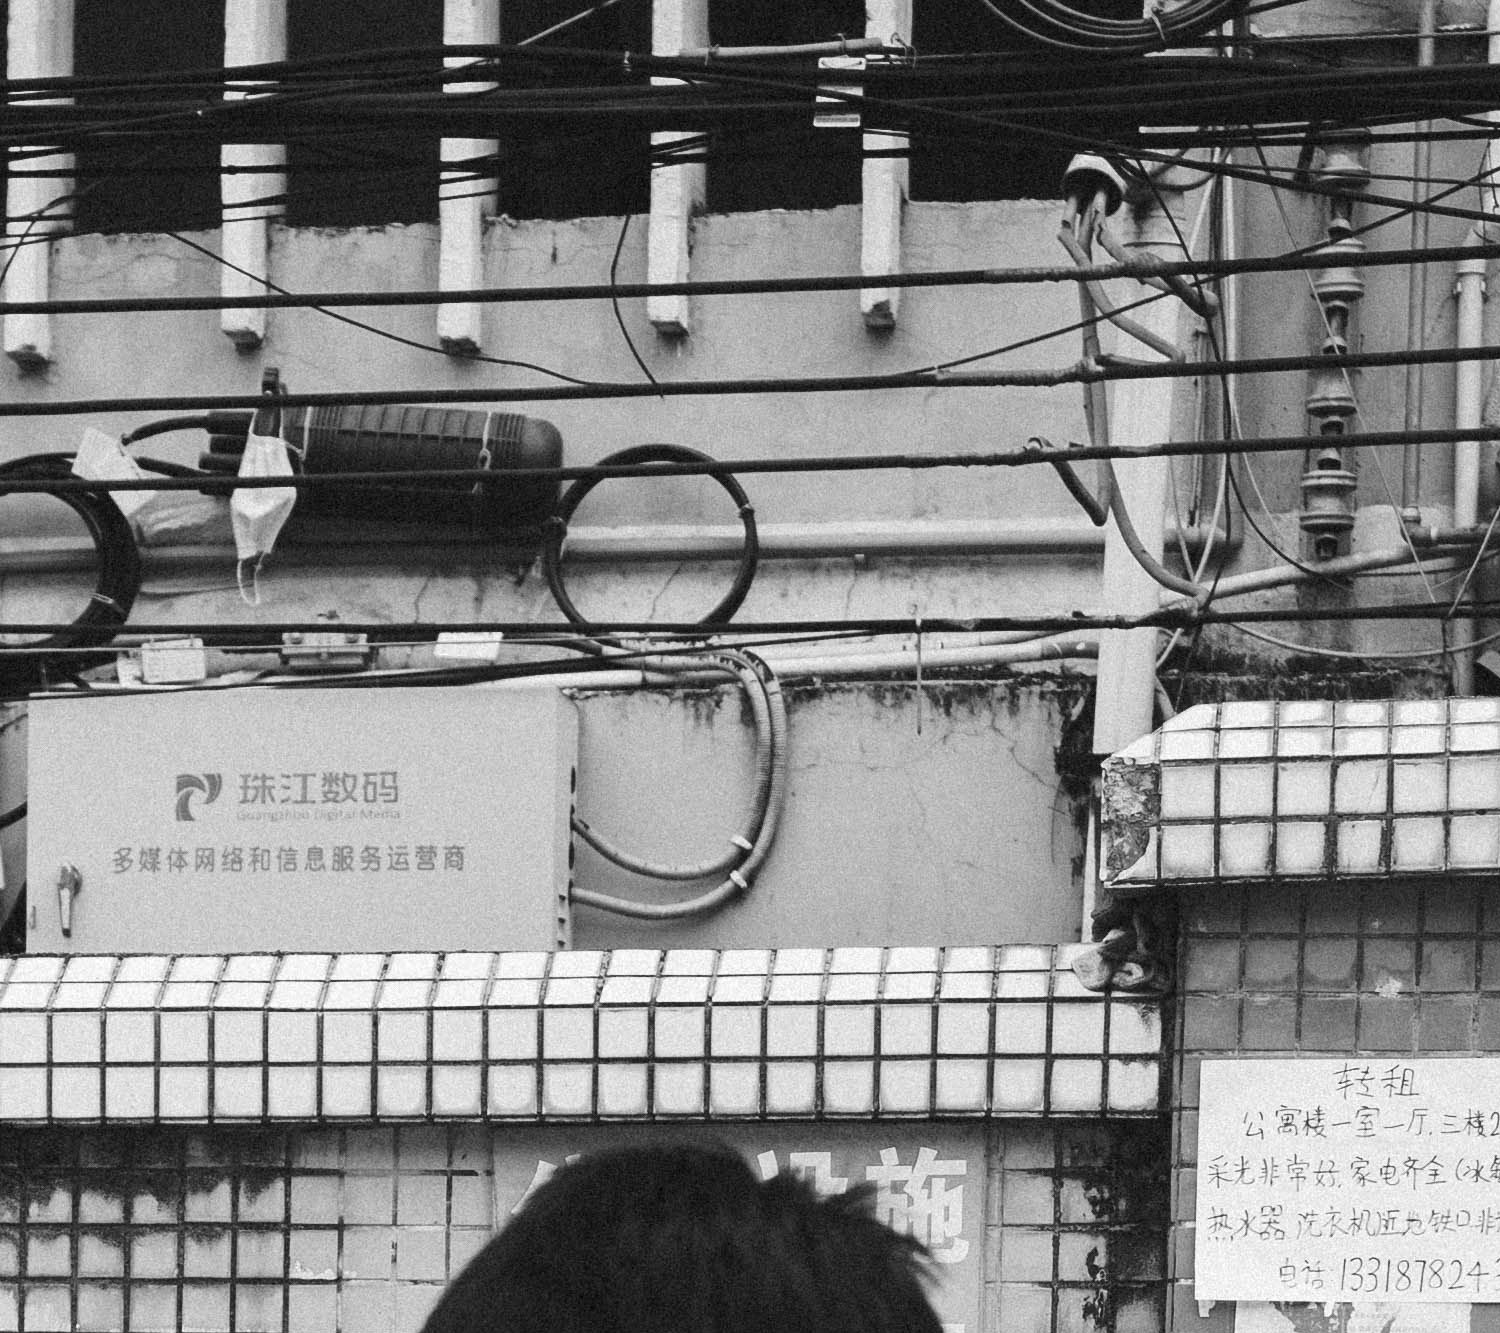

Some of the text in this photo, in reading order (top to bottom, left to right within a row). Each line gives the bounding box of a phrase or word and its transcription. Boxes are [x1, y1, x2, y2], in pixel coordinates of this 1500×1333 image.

[237, 770, 400, 805] 珠江数码
[360, 808, 401, 820] Media
[112, 844, 466, 875] 多媒体网络和信息服务运营商
[1332, 1063, 1420, 1101] 转租
